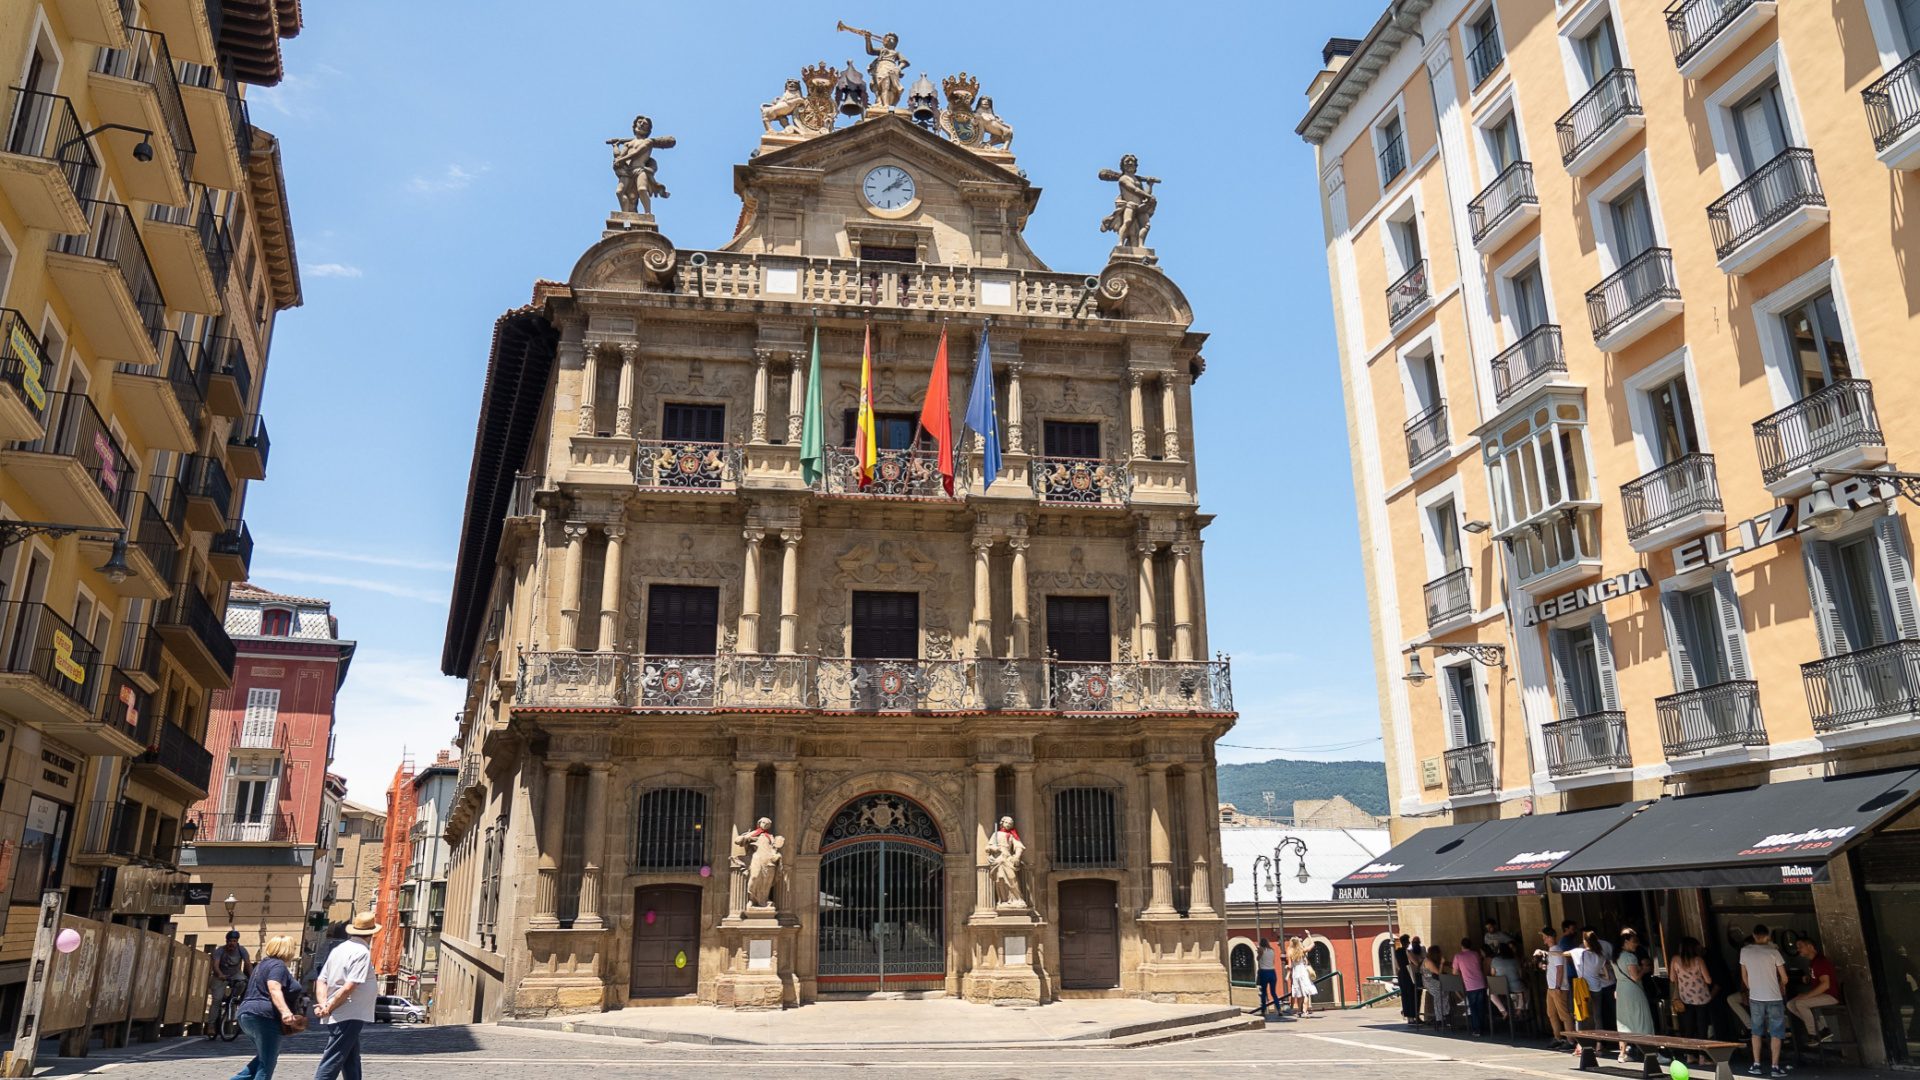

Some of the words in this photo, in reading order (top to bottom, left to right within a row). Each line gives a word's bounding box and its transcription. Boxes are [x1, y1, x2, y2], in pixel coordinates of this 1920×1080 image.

[1523, 568, 1653, 627] AGENCIA
[1752, 826, 1856, 848] Mahou
[1793, 841, 1833, 851] 1890
[1781, 865, 1813, 876] Mahou
[1560, 877, 1586, 892] BAR
[1586, 875, 1616, 891] MOL
[1338, 888, 1352, 899] BAR
[1353, 887, 1370, 899] MOL
